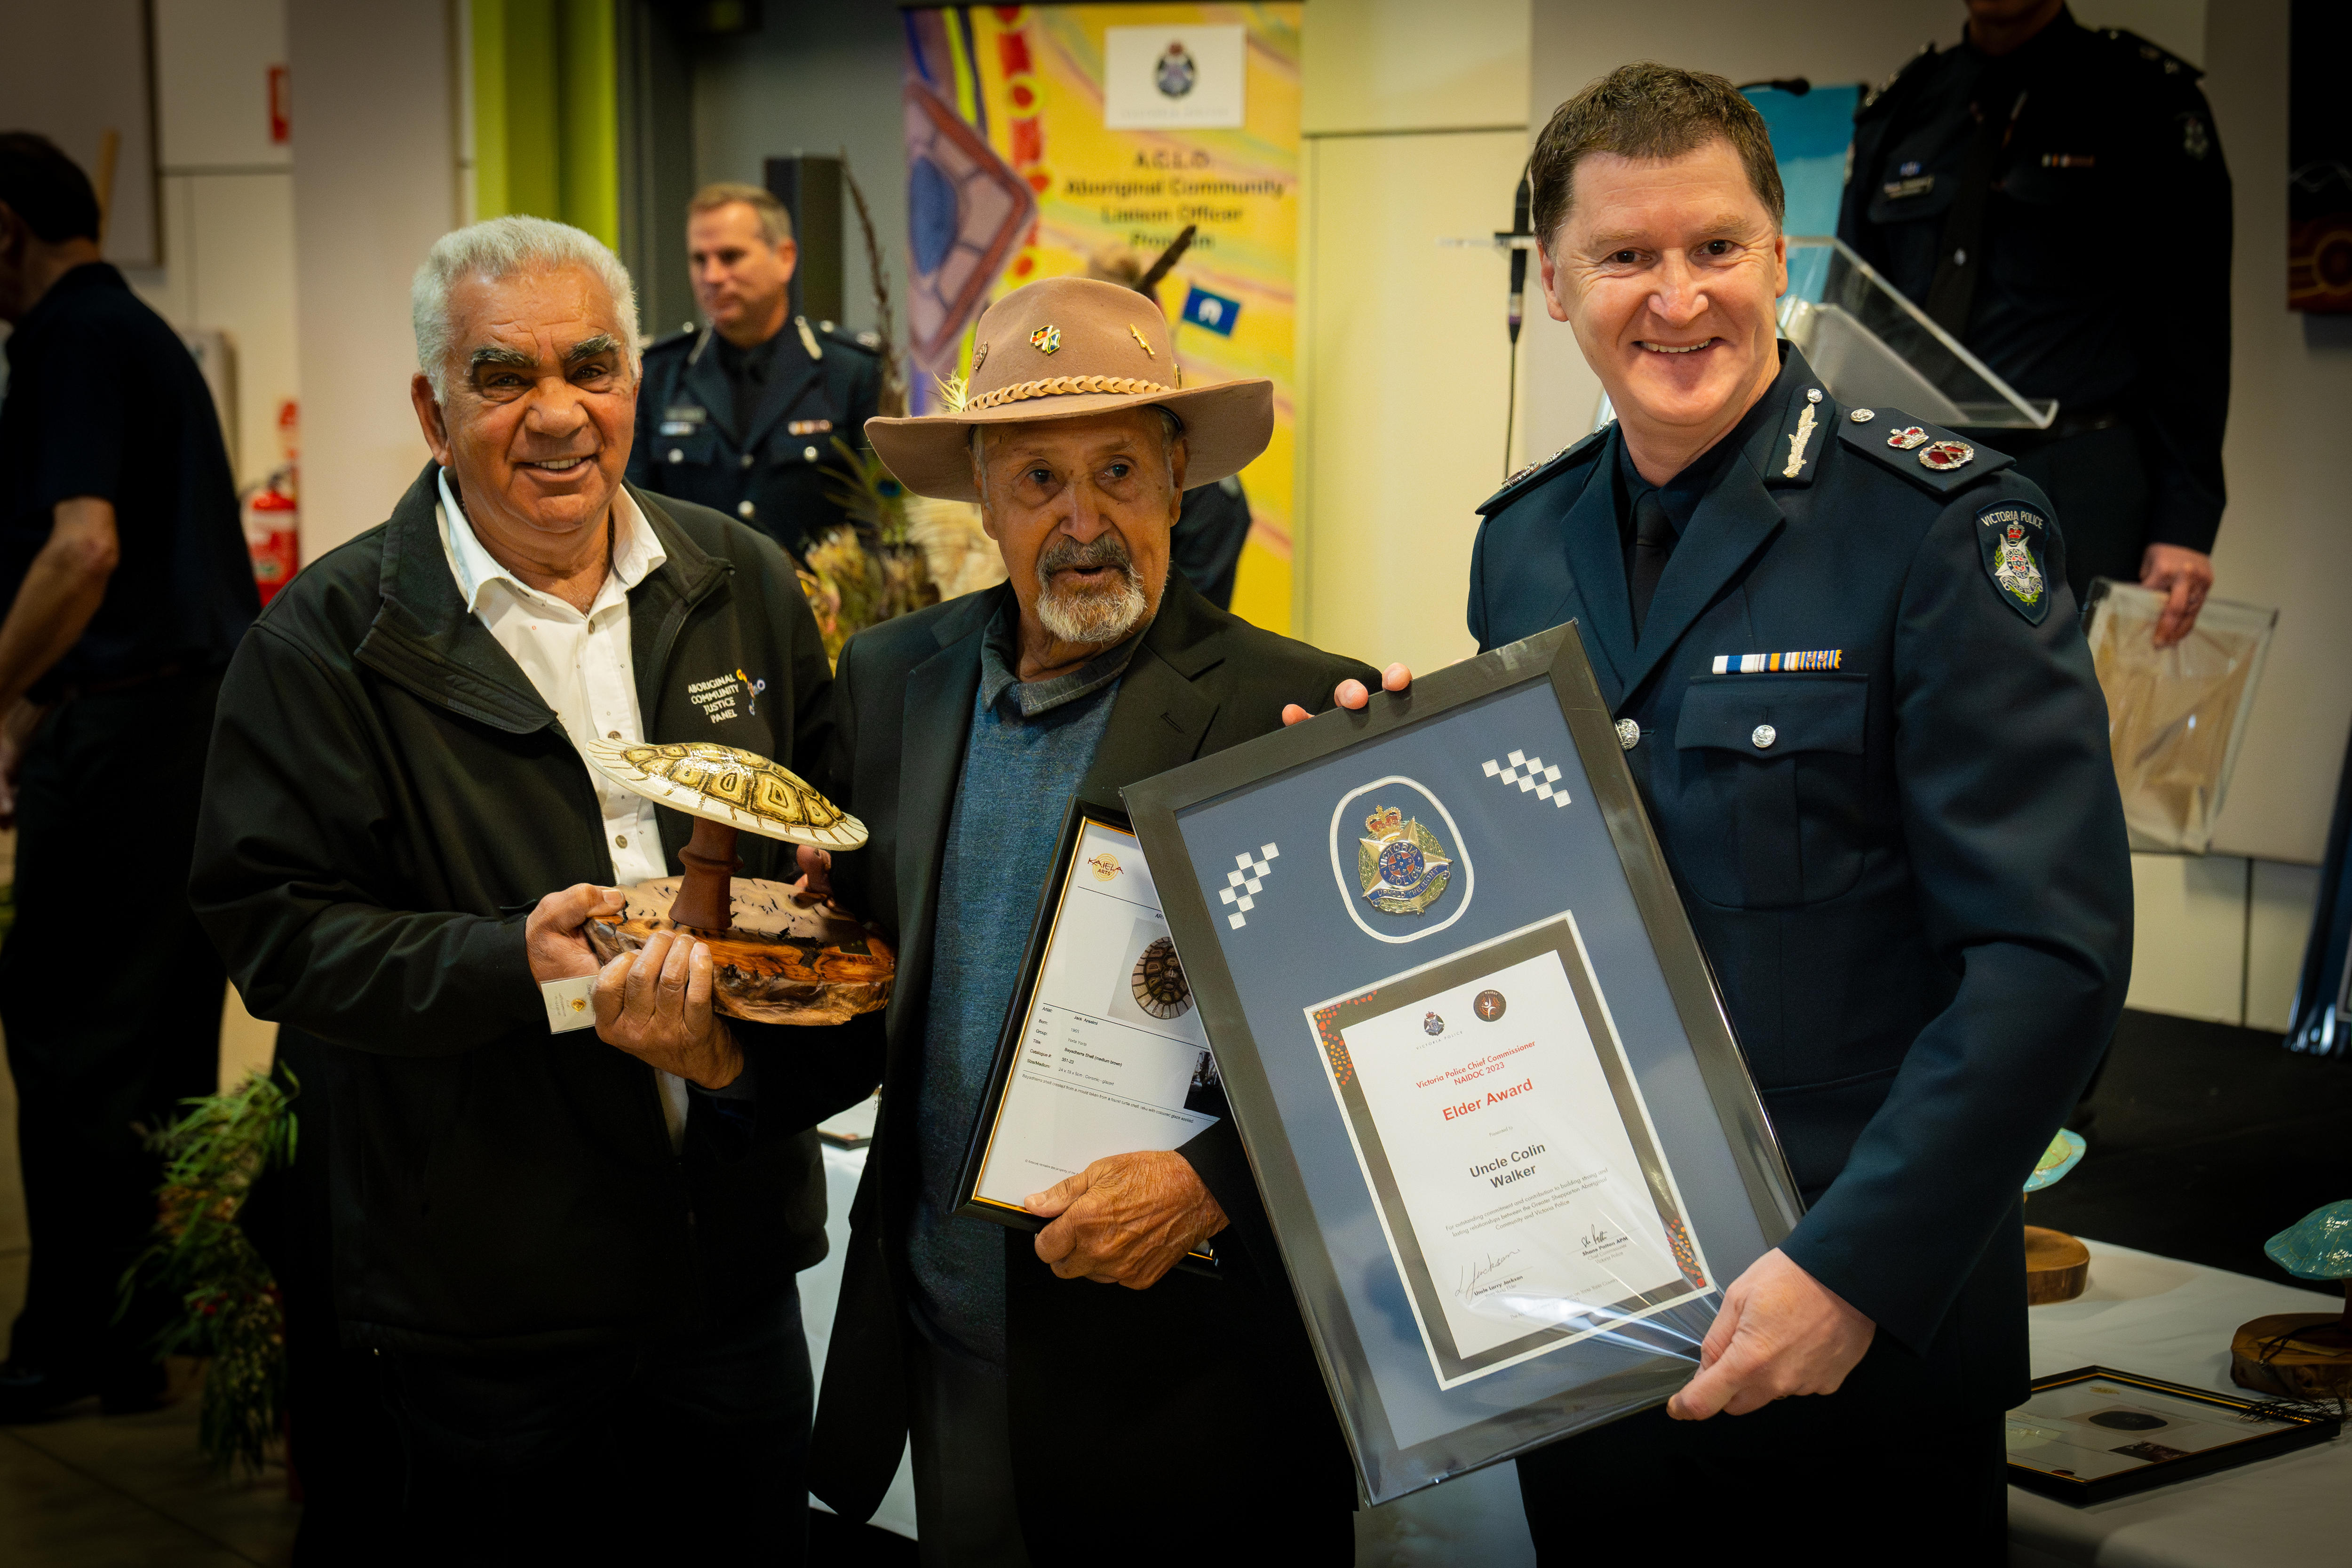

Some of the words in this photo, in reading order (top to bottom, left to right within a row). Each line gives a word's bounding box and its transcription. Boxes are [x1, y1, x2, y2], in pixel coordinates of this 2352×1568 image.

[1980, 511, 2018, 526] VICTORIA
[2020, 511, 2043, 529] POLICE
[688, 674, 736, 693] ABORIGINAL
[691, 684, 739, 704] COMMUNITY
[703, 697, 736, 715] JUSTICE
[710, 708, 738, 724] PANEL
[1380, 843, 1417, 868] VICTORIA
[1087, 857, 1124, 875] KAIELA
[1389, 865, 1422, 885] POLICE
[1416, 1039, 1441, 1050] VICTORIA
[1444, 1030, 1463, 1040] POLICE
[1416, 1075, 1444, 1088] Victoria
[1445, 1068, 1466, 1078] Police
[1468, 1058, 1486, 1070] Chief
[1487, 1042, 1535, 1062] Commissioner
[1454, 1069, 1485, 1085] NAIDOC
[1486, 1061, 1504, 1074] 2023
[1442, 1099, 1481, 1121] Elder
[1487, 1078, 1533, 1106] Award
[1470, 1158, 1508, 1177] Uncle
[1511, 1144, 1546, 1162] Colin
[1490, 1166, 1535, 1188] Walker
[1452, 1229, 1470, 1237] lasting
[1470, 1217, 1501, 1231] relationships
[1501, 1209, 1522, 1219] between
[1532, 1199, 1550, 1208] Greater
[1551, 1187, 1581, 1201] Shepparton
[1581, 1177, 1607, 1190] Aboriginal
[1455, 1215, 1484, 1227] outstanding
[1485, 1202, 1513, 1217] commitment
[1514, 1198, 1524, 1206] and
[1525, 1189, 1553, 1202] contribution
[1560, 1179, 1581, 1188] building
[1581, 1172, 1597, 1182] strong
[1598, 1167, 1608, 1175] and
[1496, 1218, 1523, 1230] Community
[1534, 1206, 1554, 1215] Victoria
[1598, 1242, 1615, 1250] Patton
[1503, 1276, 1523, 1285] Jackson
